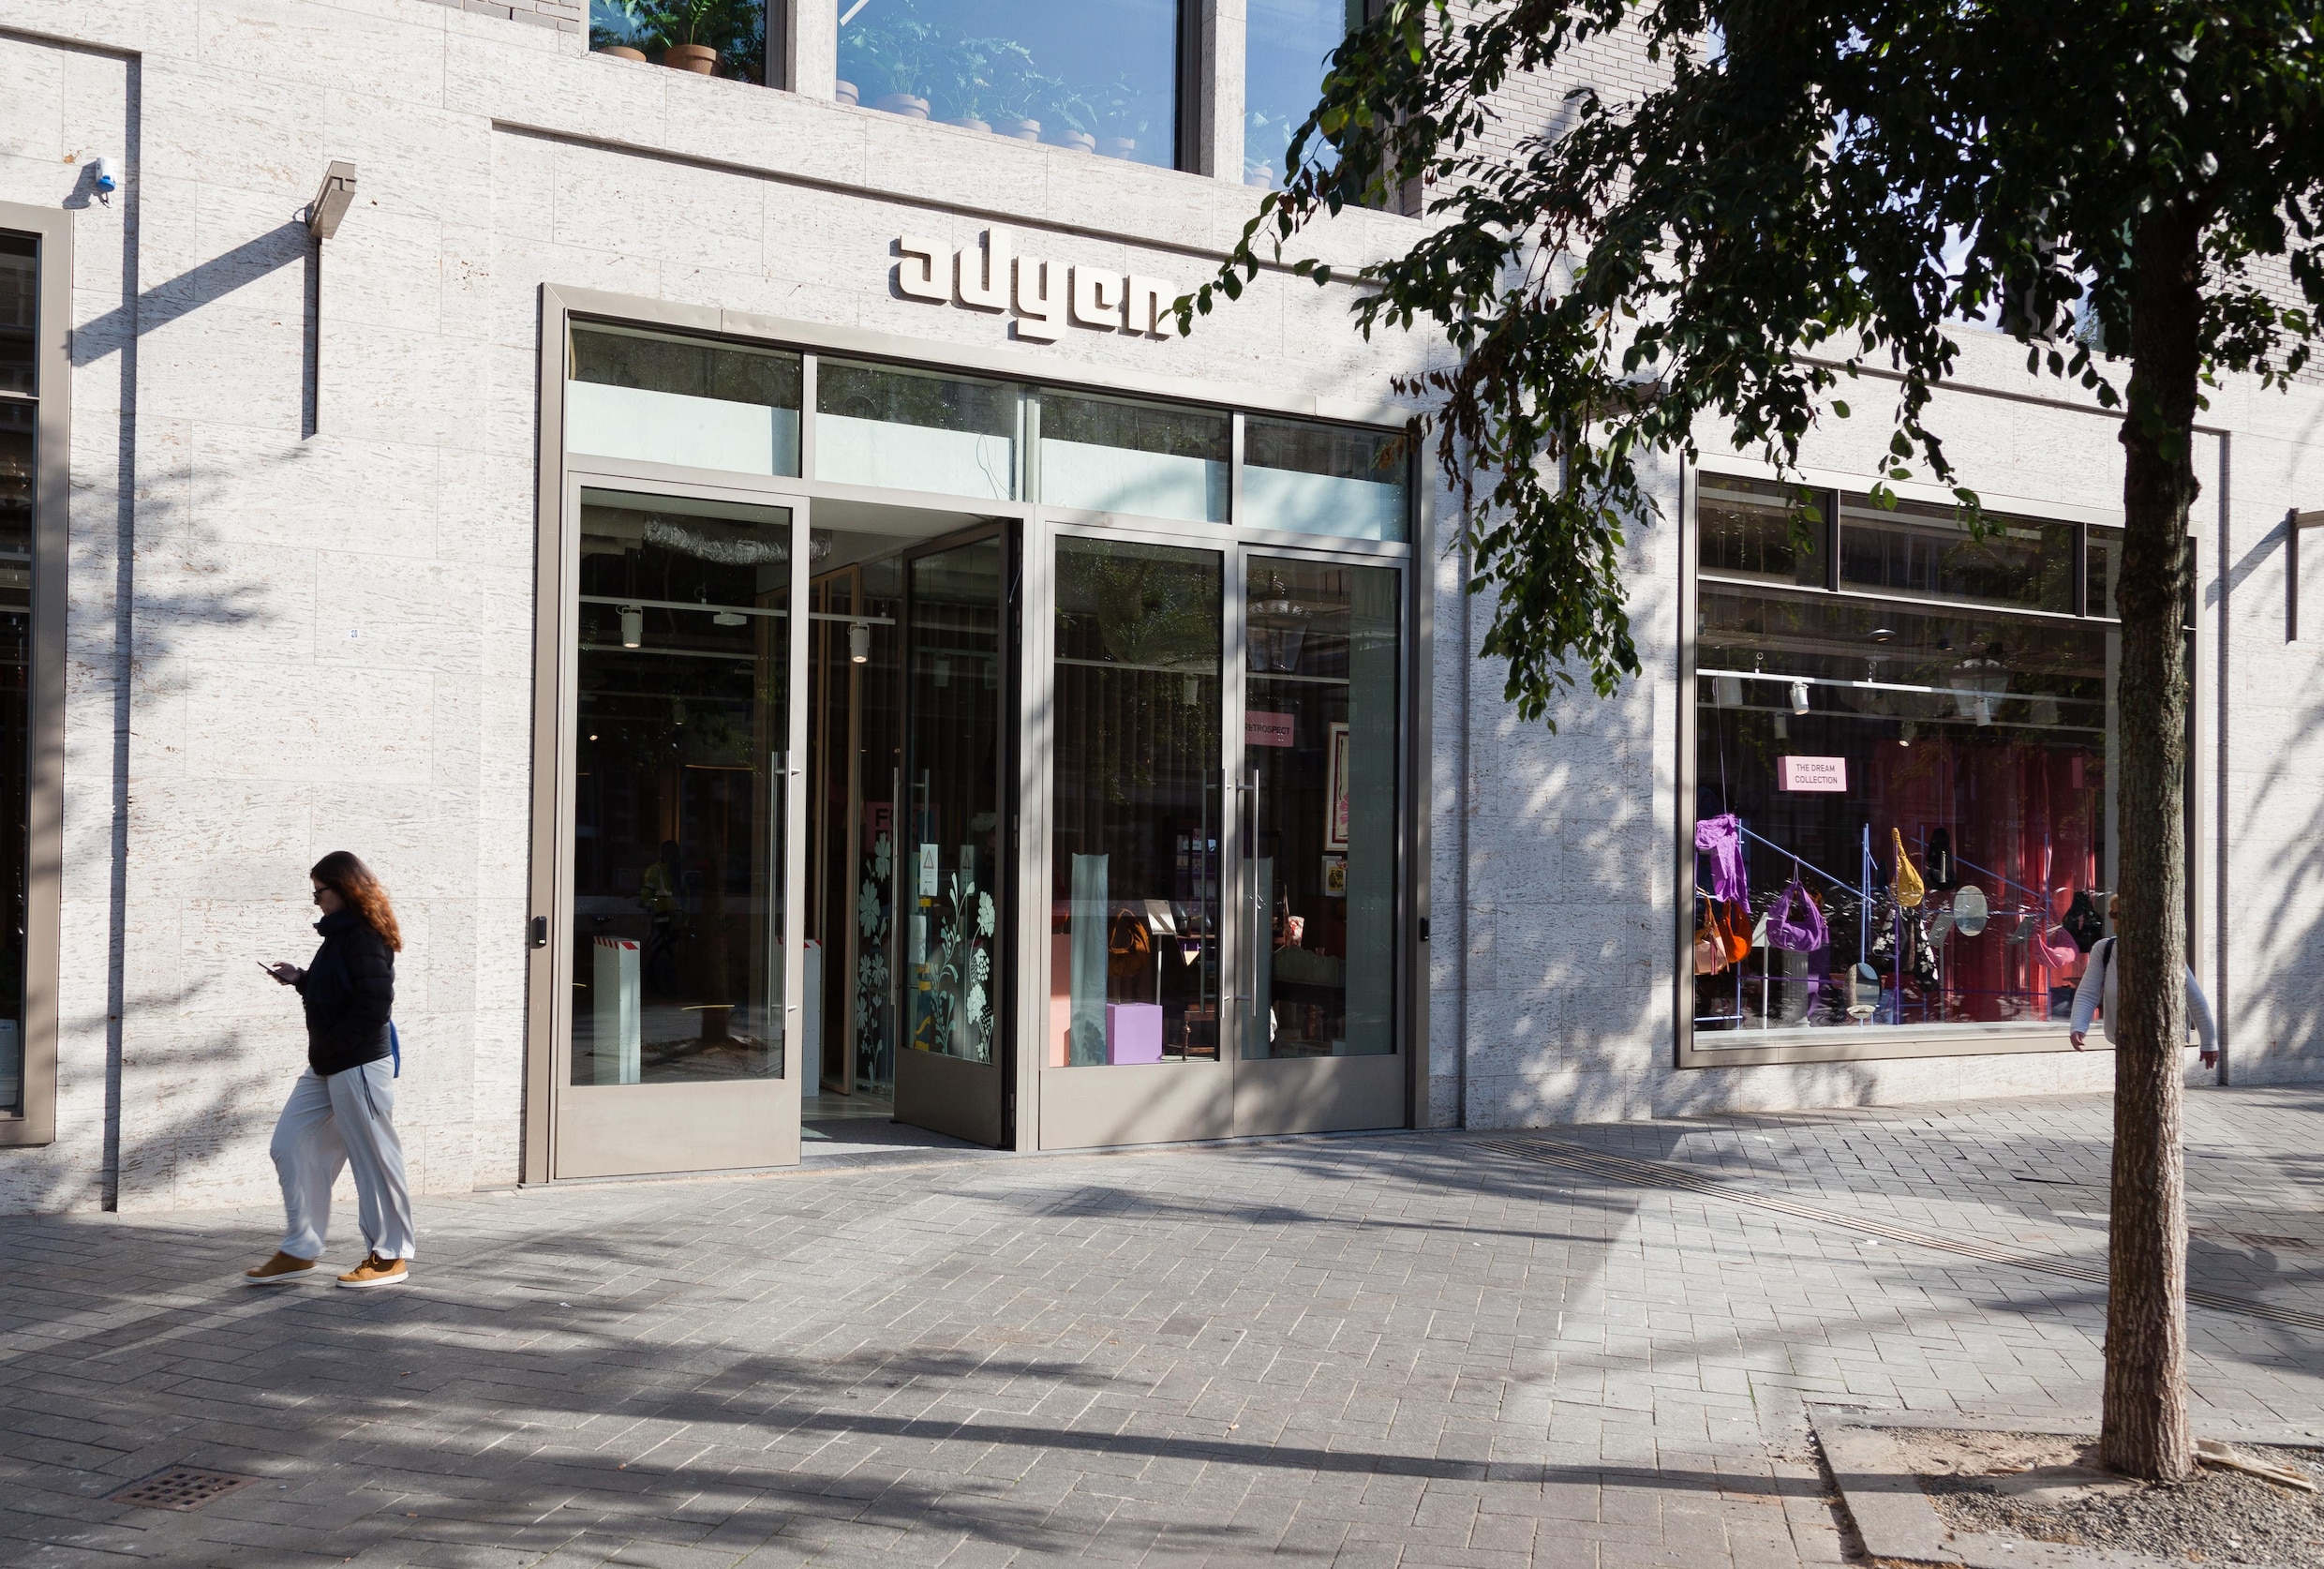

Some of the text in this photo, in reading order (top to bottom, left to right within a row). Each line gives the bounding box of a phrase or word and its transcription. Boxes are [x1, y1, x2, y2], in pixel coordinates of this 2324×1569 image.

[897, 226, 1177, 342] adyen
[1795, 763, 1835, 772] THE DREAM
[1795, 775, 1838, 784] COLLECTION
